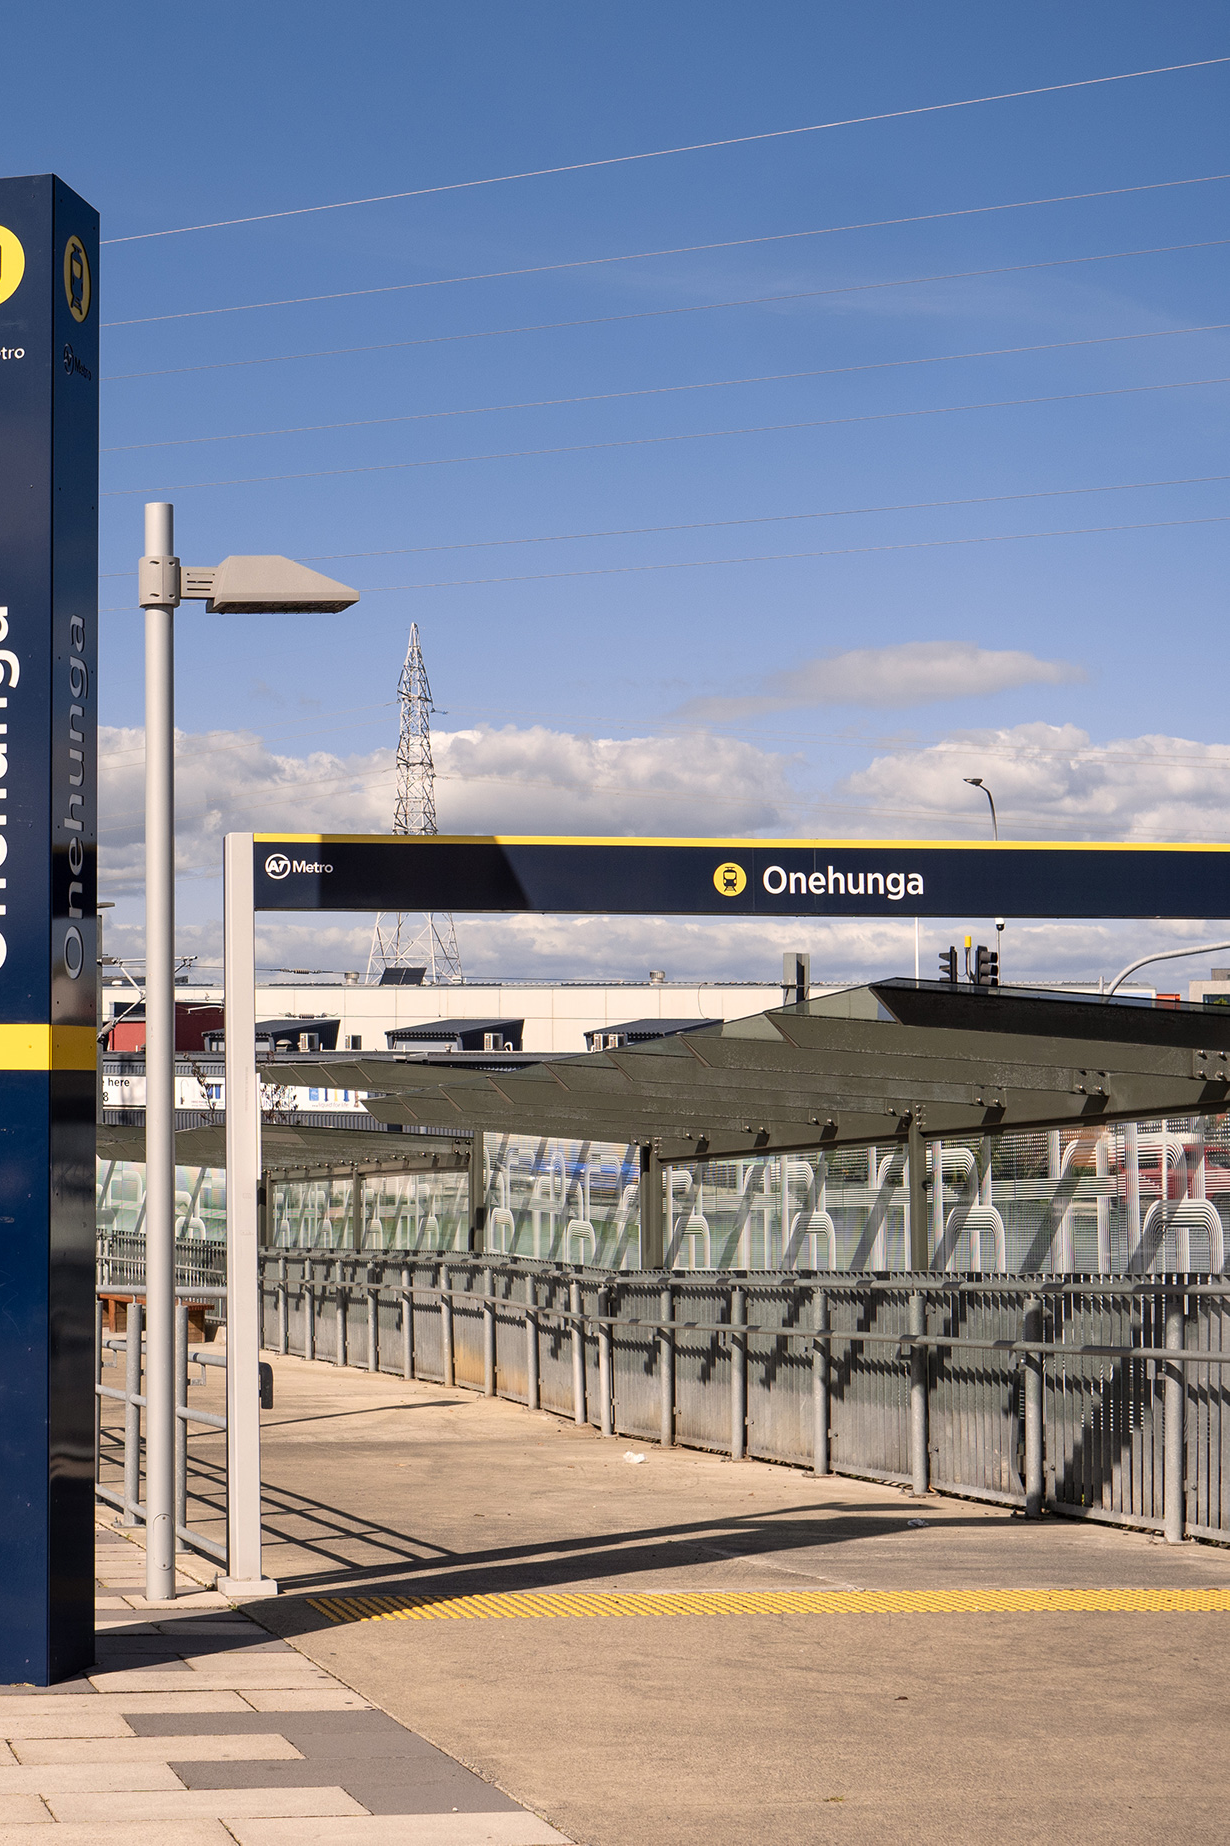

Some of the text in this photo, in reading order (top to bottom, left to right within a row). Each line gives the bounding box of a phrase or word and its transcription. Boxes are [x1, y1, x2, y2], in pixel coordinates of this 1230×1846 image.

[64, 614, 89, 980] Onehunga
[292, 860, 334, 873] Metro
[763, 865, 924, 900] Onehunga
[108, 1078, 130, 1087] here
